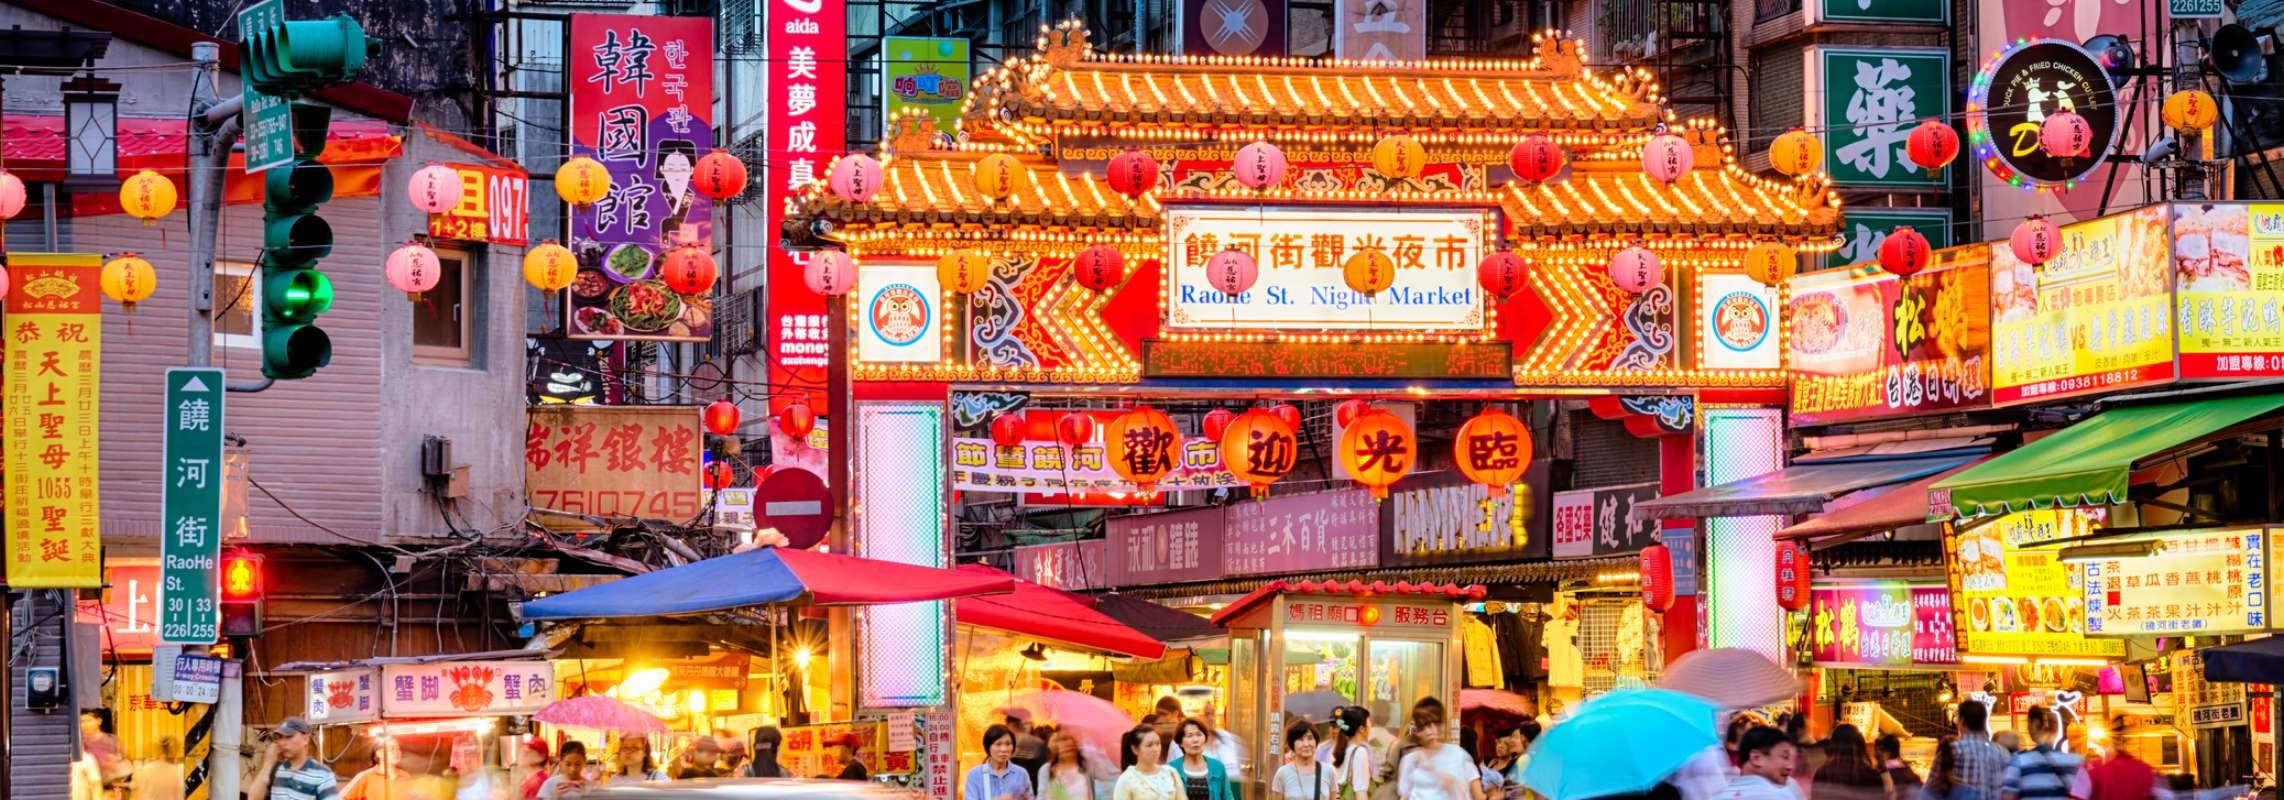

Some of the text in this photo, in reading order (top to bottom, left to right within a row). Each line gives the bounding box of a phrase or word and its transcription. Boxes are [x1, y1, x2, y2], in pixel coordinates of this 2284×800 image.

[2199, 0, 2220, 12] 255
[786, 19, 819, 34] aida
[662, 39, 690, 134] 한국관
[2011, 74, 2022, 87] PIE
[2029, 61, 2051, 72] FRIED
[2052, 61, 2084, 82] CHICKEN
[588, 28, 656, 234] 韓國館
[787, 46, 817, 189] 美夢成真
[1836, 58, 1918, 179] 藥
[853, 161, 864, 195] 天上聖母
[489, 174, 528, 240] 097
[431, 221, 487, 240] 1+2樓
[1267, 285, 1295, 305] St.
[1388, 285, 1472, 305] Market
[1893, 264, 1968, 361] 松鶴
[15, 321, 89, 344] 恭祝
[2070, 324, 2086, 351] VS
[525, 421, 695, 475] 瑞祥銀樓
[1123, 427, 1174, 475] 歡
[1247, 430, 1292, 476] 迎
[1356, 430, 1407, 473] 光
[1469, 431, 1518, 470] 臨
[175, 399, 211, 548] 饒河街
[1267, 508, 1330, 556] 三禾百貨
[1394, 483, 1517, 553] HAMMER
[1600, 493, 1661, 548] 健和
[166, 554, 213, 570] RaoHe
[166, 576, 185, 591] St.
[2245, 534, 2262, 627] 實在老口味
[168, 598, 183, 612] 30
[196, 598, 211, 612] 33
[1288, 603, 1360, 623] 媽祖廟口
[1394, 606, 1448, 626] 服務台
[164, 624, 187, 638] 226
[192, 624, 215, 638] 255
[503, 674, 547, 700] 蟹肉
